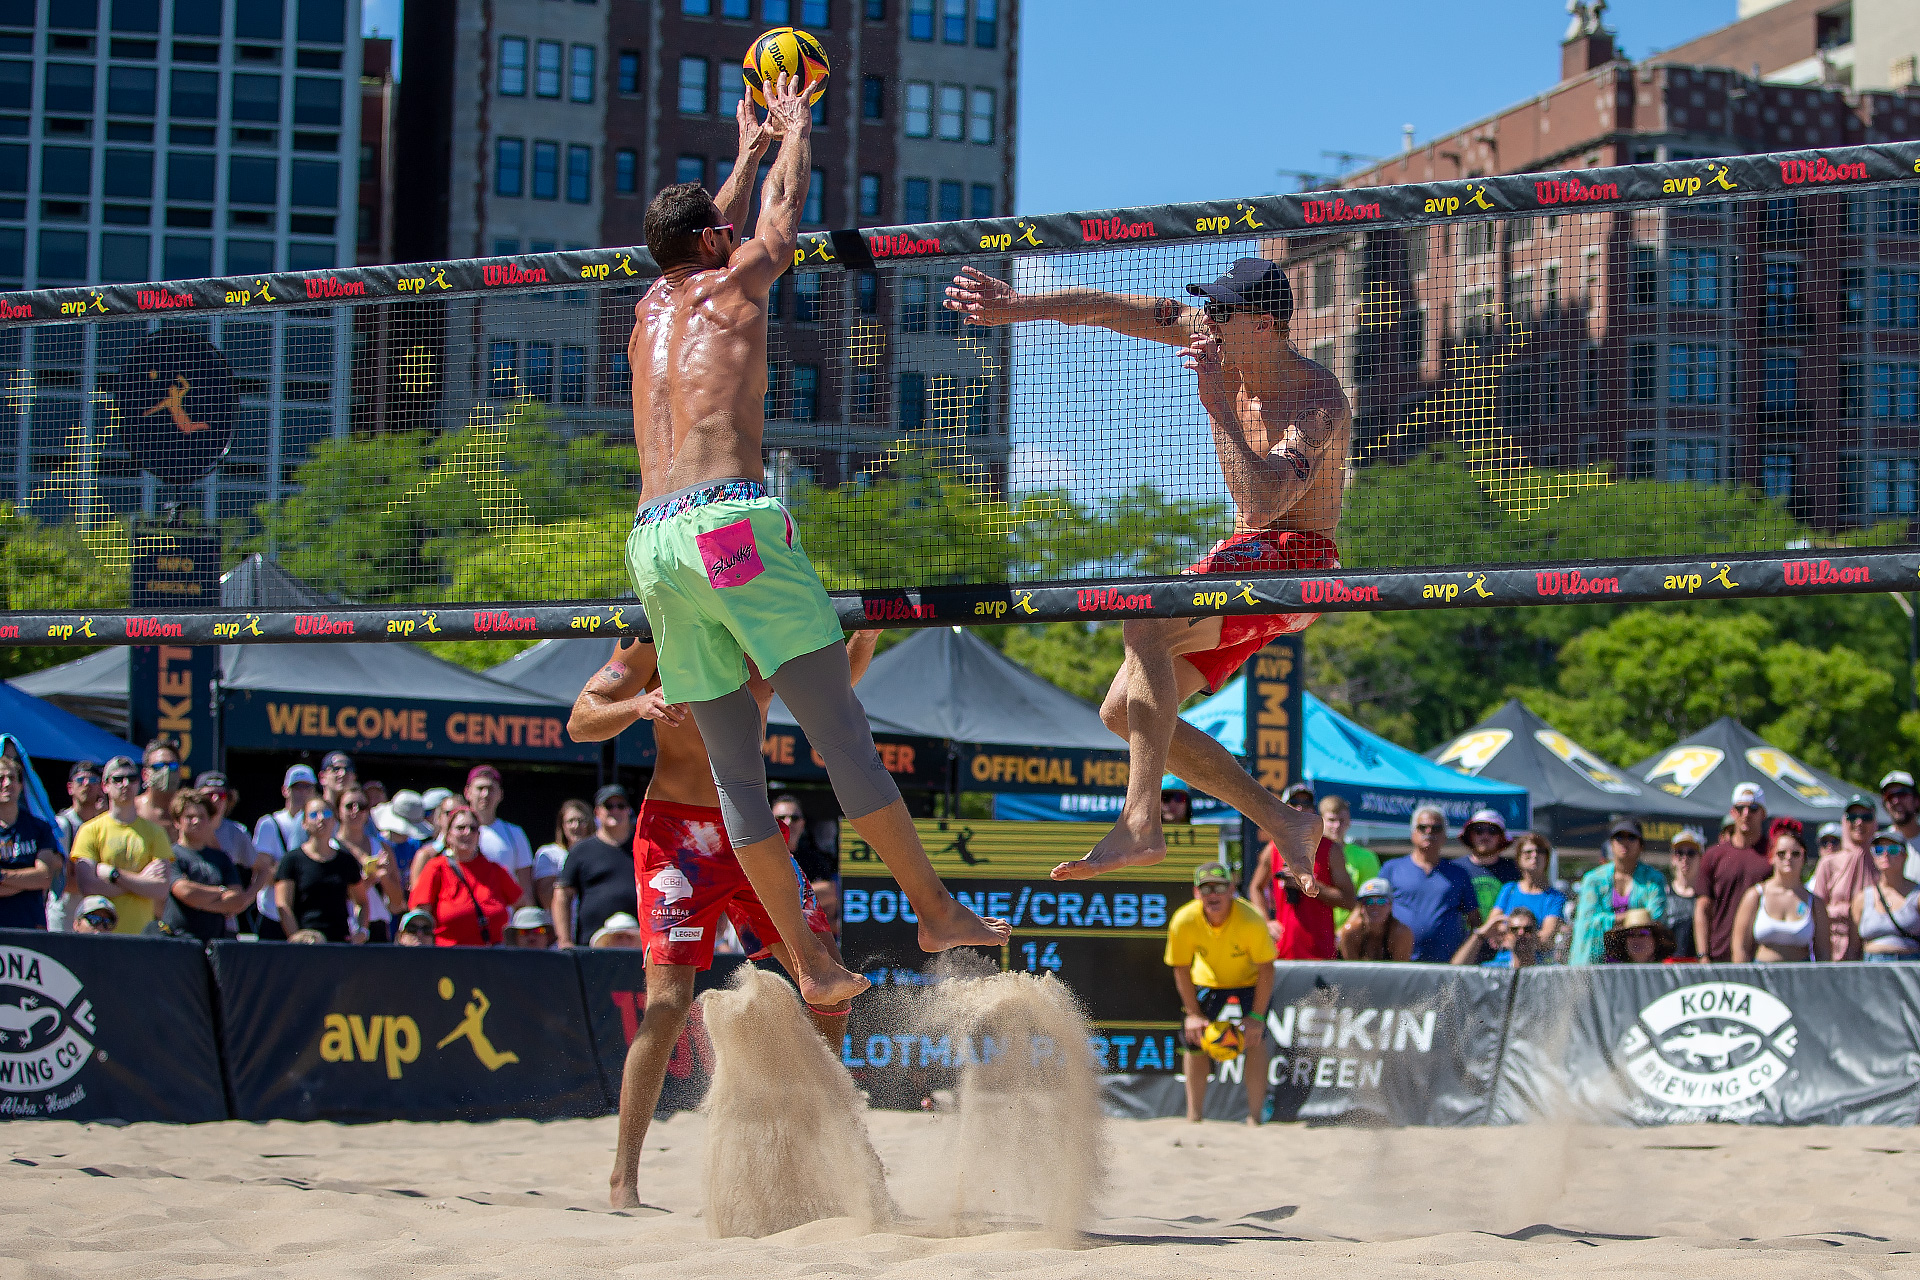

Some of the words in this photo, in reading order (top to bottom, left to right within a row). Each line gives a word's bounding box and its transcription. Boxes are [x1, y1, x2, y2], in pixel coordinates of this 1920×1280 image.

[0, 300, 33, 318] lson
[61, 301, 86, 317] avp
[137, 289, 195, 311] Wilson
[225, 290, 250, 306] avp
[304, 277, 366, 298] Wilson
[397, 276, 425, 293] avp
[482, 263, 549, 287] Wilson
[580, 262, 610, 280] avp
[868, 233, 941, 258] Wilson
[979, 233, 1012, 252] avp
[1080, 216, 1156, 242] Wilson
[1195, 215, 1230, 235] avp
[1301, 198, 1382, 225] Wilson
[1424, 195, 1460, 216] avp
[1534, 178, 1622, 204] Wilson
[1662, 176, 1701, 196] avp
[1779, 157, 1870, 185] Wilson
[47, 623, 73, 640] avp
[125, 618, 184, 637] Wilson
[213, 621, 240, 639] avp
[294, 615, 356, 635] Wilson
[386, 619, 415, 636] avp
[473, 610, 539, 632] Wilson
[570, 615, 601, 633] avp
[864, 598, 937, 620] Wilson
[974, 599, 1008, 618] avp
[1076, 587, 1156, 611] Wilson
[1192, 590, 1228, 610] avp
[1300, 579, 1383, 604] Wilson
[1422, 582, 1459, 602] avp
[1535, 571, 1622, 596] Wilson
[1663, 573, 1702, 593] avp
[1782, 560, 1875, 586] Wilson
[266, 702, 427, 742] WELCOME
[446, 711, 564, 749] CENTER
[1257, 682, 1290, 796] MER
[971, 754, 1078, 786] OFFICIAL
[1083, 759, 1131, 787] MER
[671, 908, 690, 916] BEAR
[843, 886, 1168, 928] BOUNE/CRABB
[1022, 941, 1064, 972] 14
[1680, 989, 1752, 1016] KONA
[320, 1013, 421, 1080] avp
[1639, 1061, 1740, 1098] BREWING
